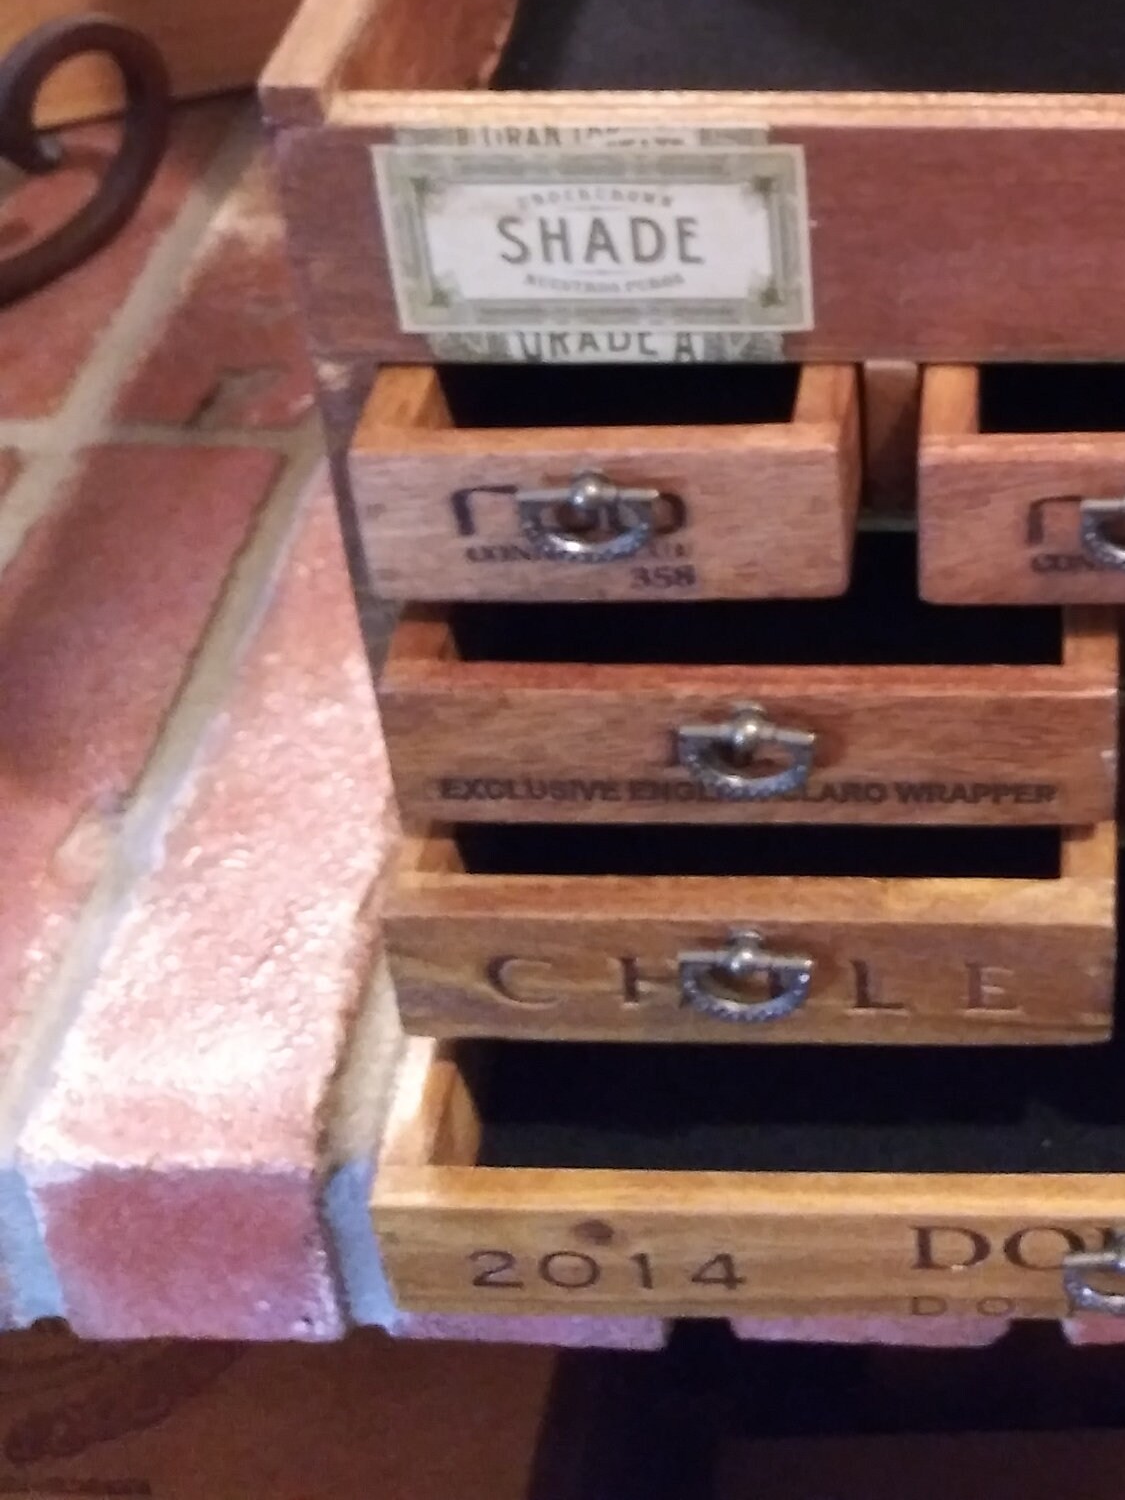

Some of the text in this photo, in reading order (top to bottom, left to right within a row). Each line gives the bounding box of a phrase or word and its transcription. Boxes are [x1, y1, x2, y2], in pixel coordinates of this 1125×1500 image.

[496, 214, 705, 266] SHADE
[440, 776, 622, 803] EXCLUSIVE
[894, 781, 1058, 806] WRAPPER
[470, 1250, 746, 1290] 2014
